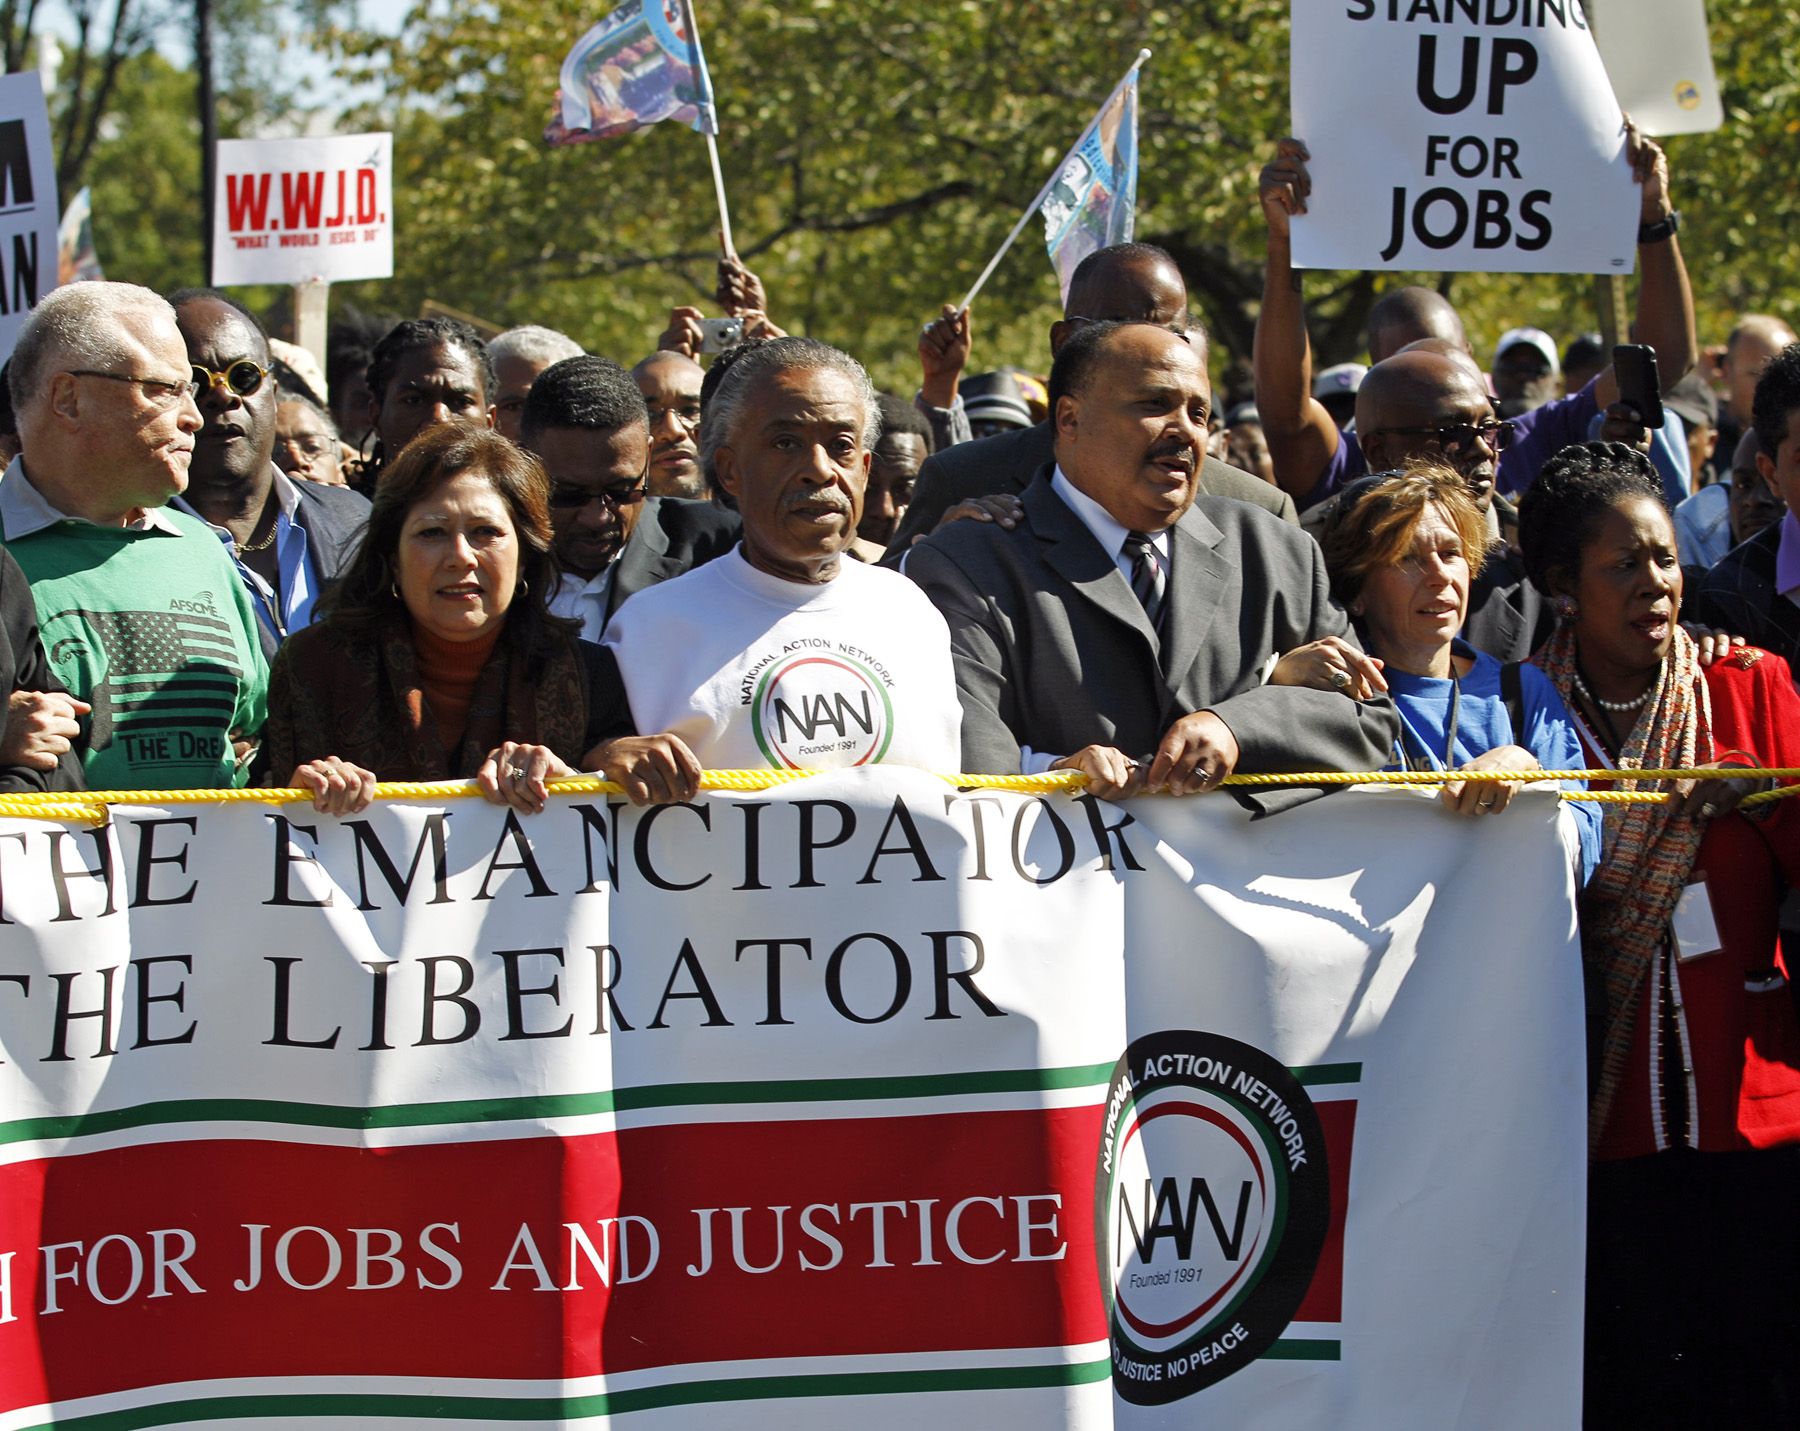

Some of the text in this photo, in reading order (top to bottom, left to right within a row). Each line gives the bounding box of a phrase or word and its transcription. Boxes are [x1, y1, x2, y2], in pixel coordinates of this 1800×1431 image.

[1417, 34, 1538, 115] UP
[1425, 135, 1523, 179] FOR
[280, 233, 319, 248] WOULD
[329, 231, 356, 245] JESUS
[1380, 187, 1552, 262] JOBS
[169, 598, 218, 617] AFSCME
[741, 637, 896, 706] NATIONAL ACTION NETWORK
[118, 730, 224, 762] THE DRE
[773, 690, 873, 744] NAN
[798, 739, 857, 756] Founded 1991
[263, 794, 1147, 911] EMANCIPATOR
[261, 928, 1009, 1052] LIBERATOR
[1103, 1053, 1308, 1175] NATIONAL ACTION NETWORK
[38, 1228, 207, 1316] FOR
[233, 1221, 464, 1292] JOBS
[490, 1214, 661, 1292] AND
[686, 1192, 1068, 1278] JUSTICE
[1116, 1176, 1254, 1268] NAN
[1129, 1266, 1204, 1289] Founded 1991
[1118, 1356, 1163, 1382] JUSTICE
[1167, 1358, 1188, 1379] NO
[1189, 1322, 1250, 1371] PEACE
